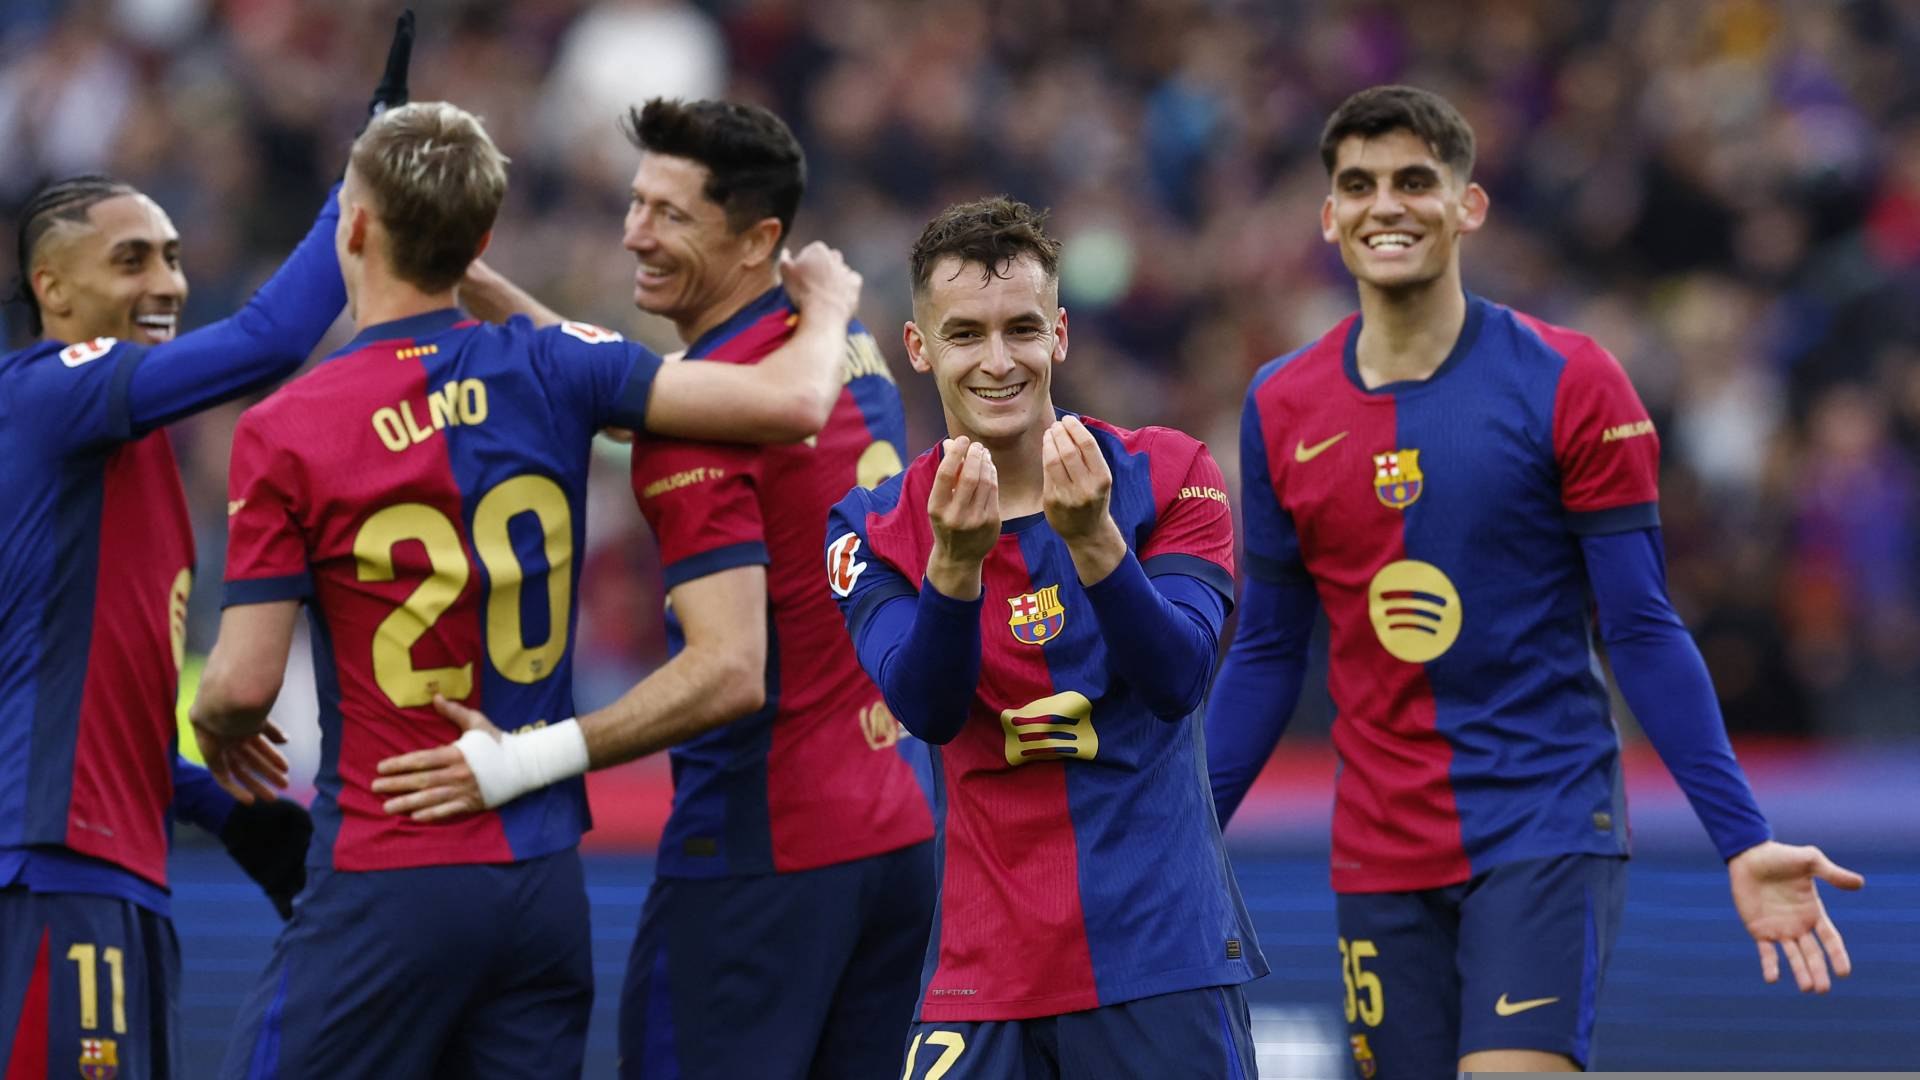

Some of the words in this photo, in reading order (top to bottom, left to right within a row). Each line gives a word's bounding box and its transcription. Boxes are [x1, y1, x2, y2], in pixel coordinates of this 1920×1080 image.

[1178, 486, 1227, 506] BILIGHT
[353, 474, 573, 708] 20
[66, 943, 127, 1034] 11
